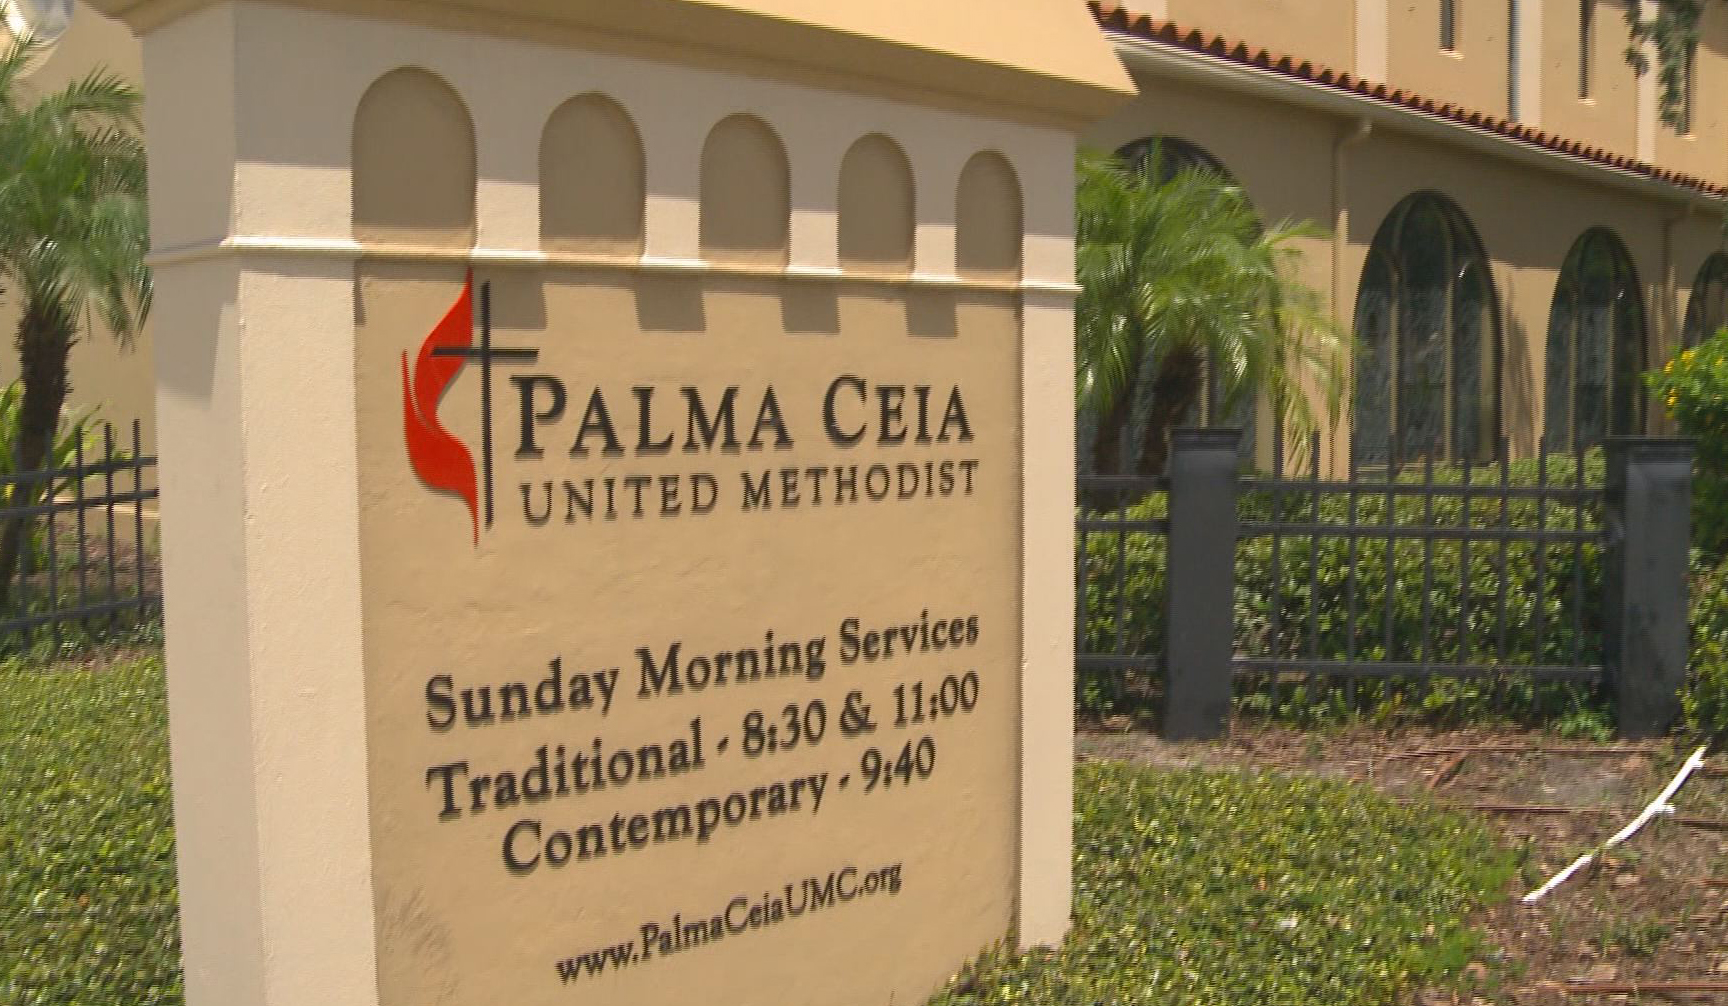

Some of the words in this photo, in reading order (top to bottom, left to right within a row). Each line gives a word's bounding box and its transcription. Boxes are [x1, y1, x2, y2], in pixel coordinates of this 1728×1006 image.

[509, 374, 794, 459] PALMA
[822, 374, 975, 446] CEIA
[519, 472, 719, 527] UNITED
[741, 459, 979, 512] METHODIST
[425, 657, 619, 731] Sunday
[635, 630, 826, 699] Morning
[839, 609, 979, 663] Services
[426, 717, 705, 822] Traditional
[742, 699, 827, 758] 8:30
[839, 690, 877, 737] &
[893, 671, 979, 728] 11:00
[502, 770, 827, 875] Contemporary
[861, 736, 936, 793] 9:40
[555, 861, 902, 985] www.PalmaCeiaUMC.org
